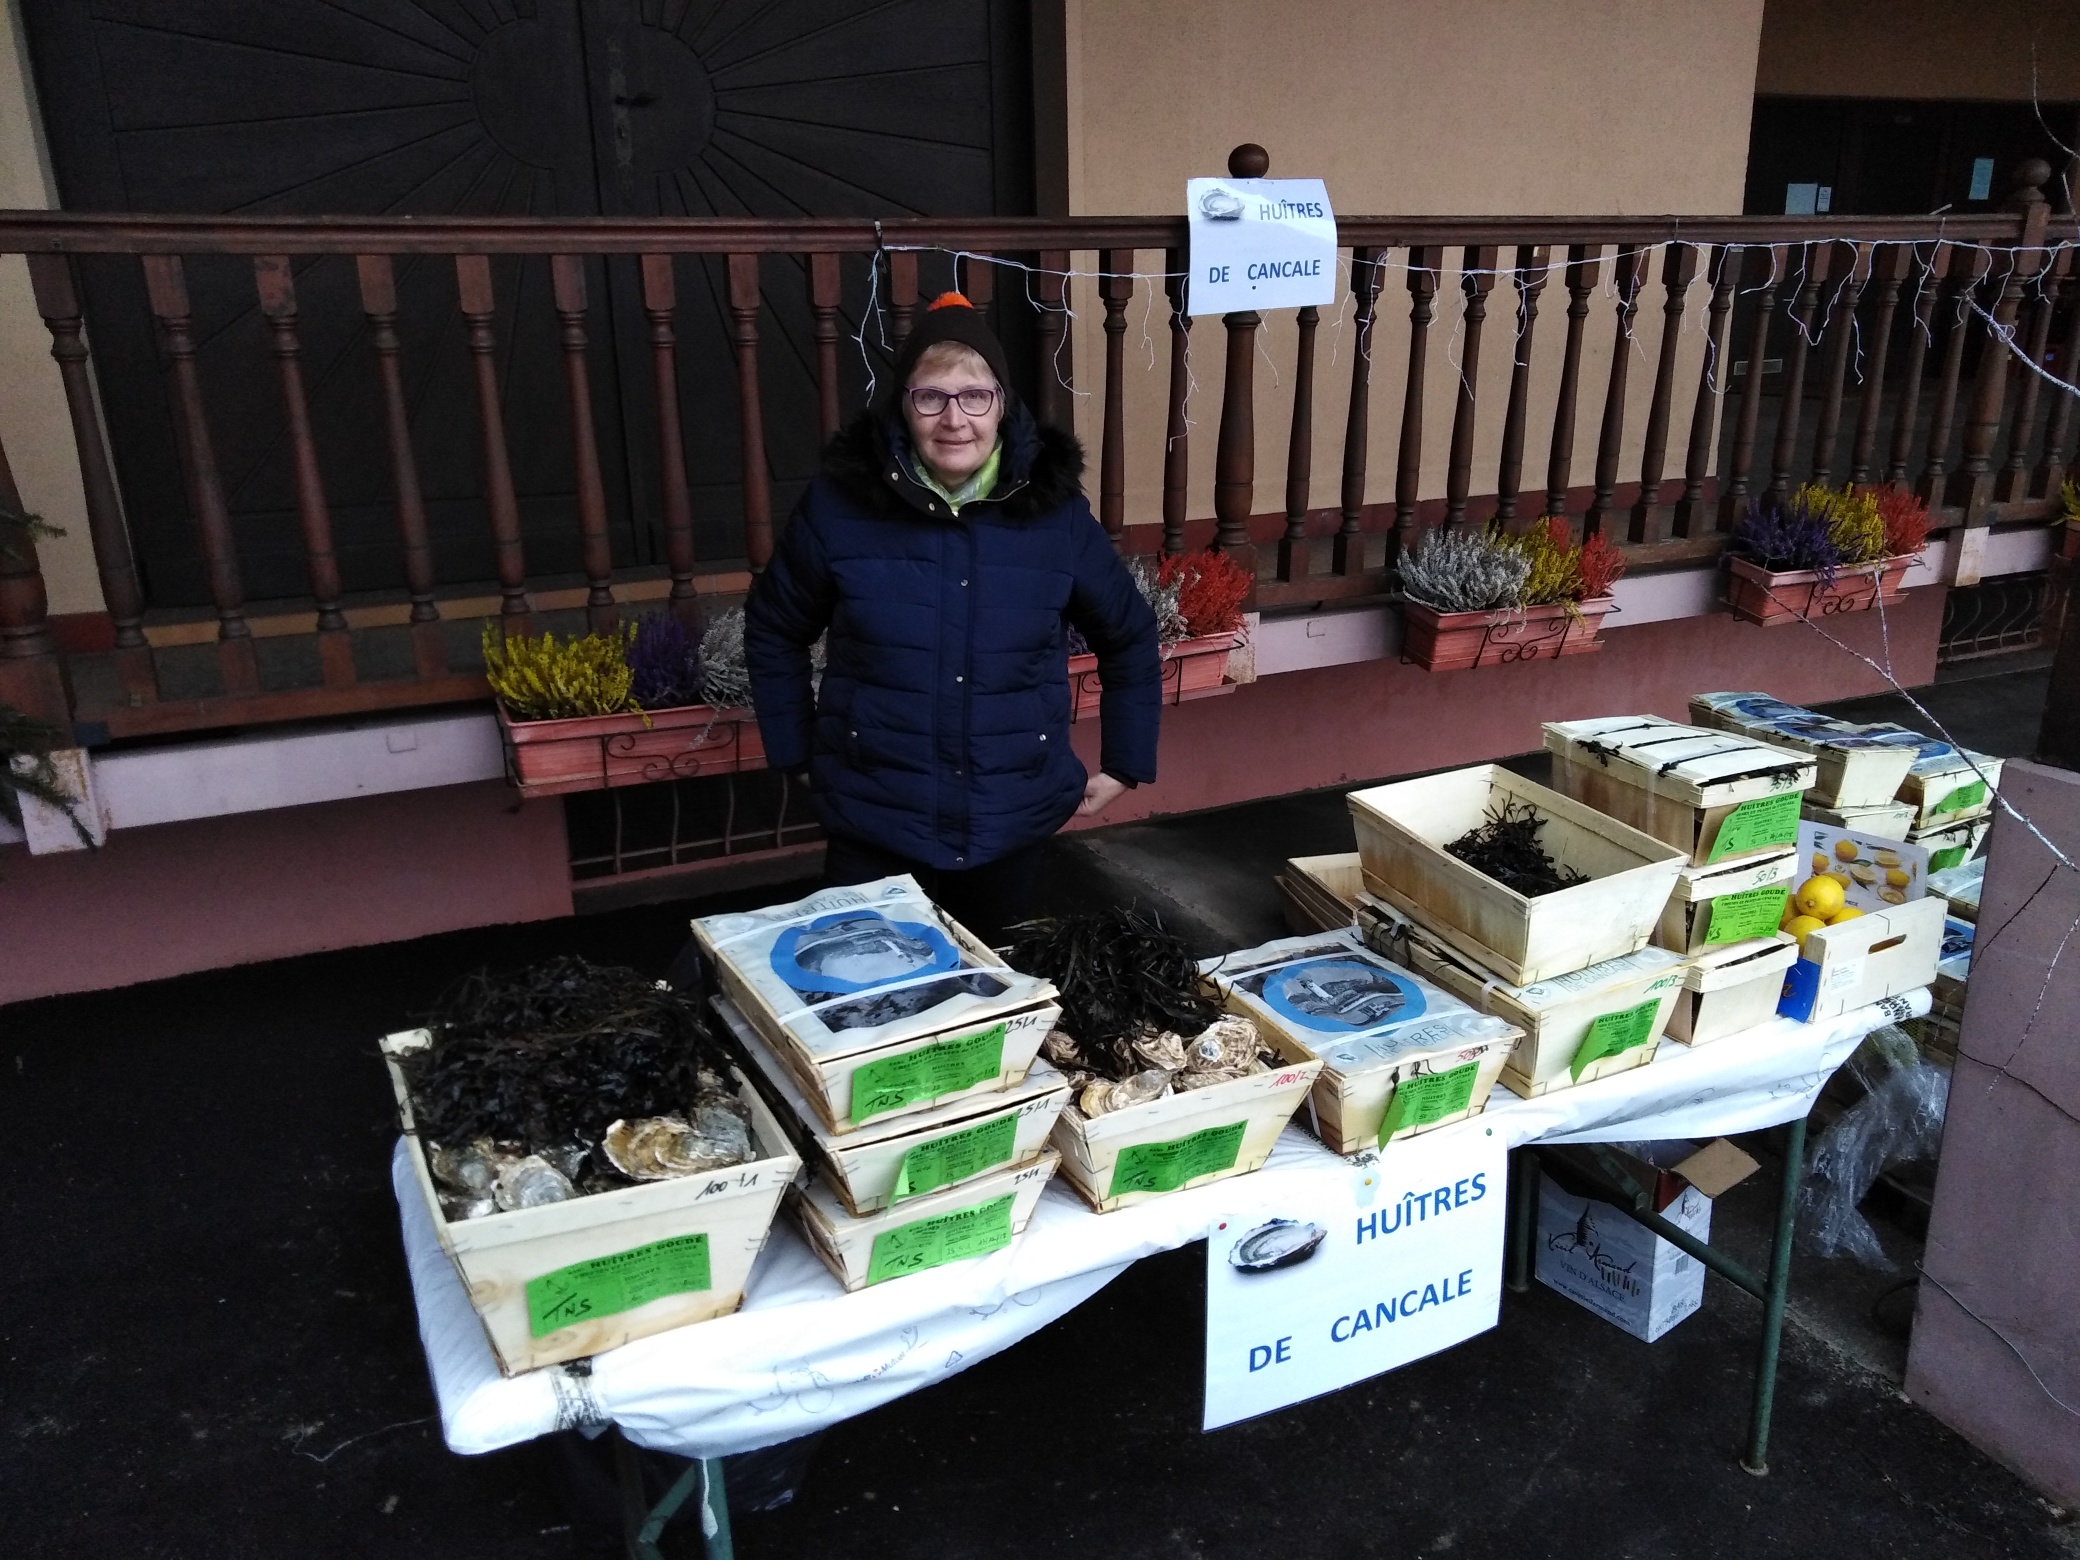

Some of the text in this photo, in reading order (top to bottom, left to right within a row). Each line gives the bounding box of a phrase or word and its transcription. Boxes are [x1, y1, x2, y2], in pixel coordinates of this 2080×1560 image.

[1259, 199, 1324, 221] HUÎTRES
[1209, 259, 1321, 284] DE CANCALE
[1356, 1172, 1487, 1245] HUÎTRES
[1560, 1260, 1578, 1275] VIN
[1248, 1269, 1473, 1373] DE CANCALE
